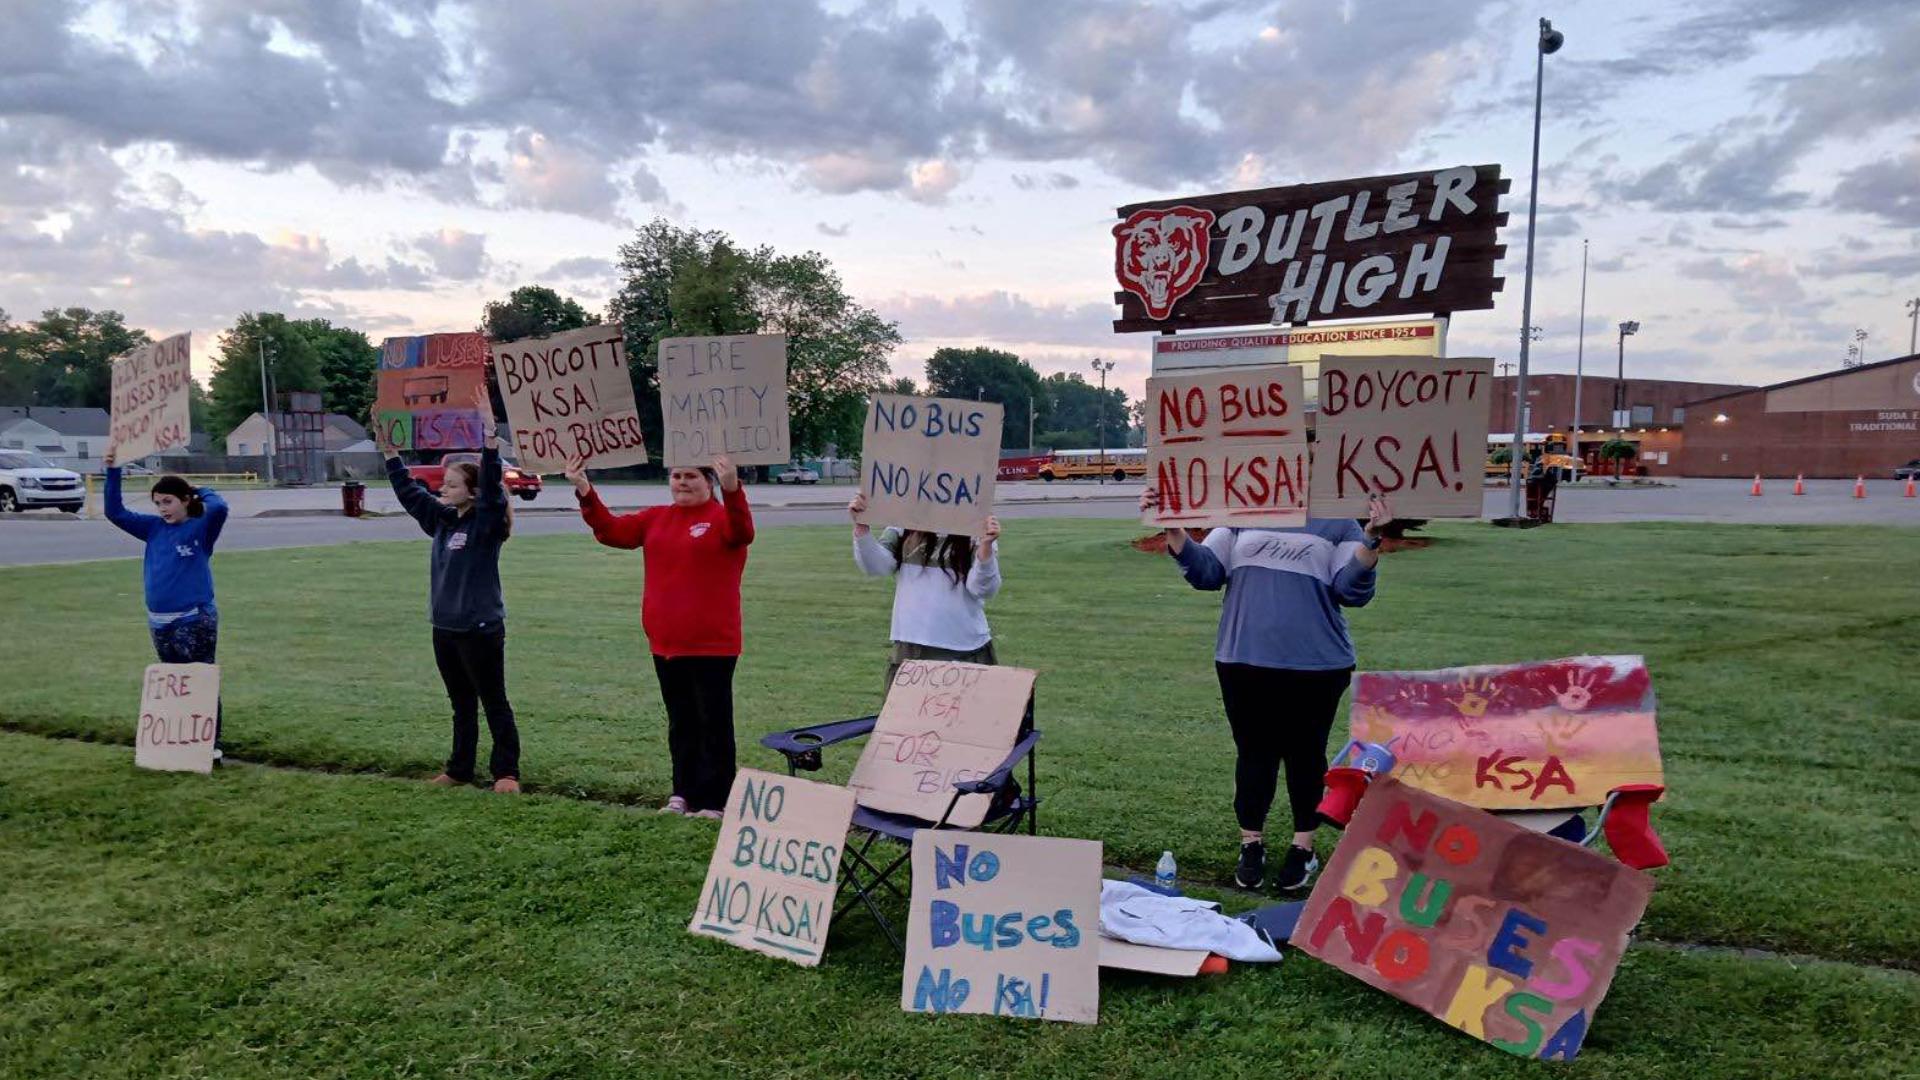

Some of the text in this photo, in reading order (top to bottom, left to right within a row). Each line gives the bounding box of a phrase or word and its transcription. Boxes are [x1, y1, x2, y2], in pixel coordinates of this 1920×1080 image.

[1217, 165, 1478, 276] BUTLER
[1268, 236, 1452, 326] HIGH
[154, 335, 189, 368] OUR
[665, 340, 746, 377] FIRE
[1171, 327, 1417, 351] PROVIDING QUALITY EDUCATION SINCE 1954
[502, 337, 623, 394] BOYCOTT
[532, 378, 600, 422] KSA!
[669, 385, 769, 423] MARTY
[1159, 382, 1289, 435] NO BUS
[1321, 368, 1488, 416] BOYCOTT
[516, 416, 643, 466] FOR BUSES
[672, 416, 780, 458] POLLIO!
[874, 400, 985, 437] NO BUS
[1849, 422, 1917, 431] TRADITIONAL
[870, 460, 982, 506] NO KSA!
[1157, 454, 1304, 514] NO KSA!
[1336, 430, 1463, 499] KSA!
[145, 669, 192, 700] FIRE
[895, 660, 989, 689] BOYCOTT
[141, 714, 214, 745] POLLIO
[869, 730, 943, 768] FOR
[1476, 749, 1575, 800] KSA
[739, 777, 784, 822] NO
[734, 825, 837, 884] BUSES
[1376, 801, 1479, 865] NO
[705, 876, 823, 945] NO KSA!
[1342, 847, 1600, 1000] BUSES
[1309, 896, 1587, 1062] NO KSA
